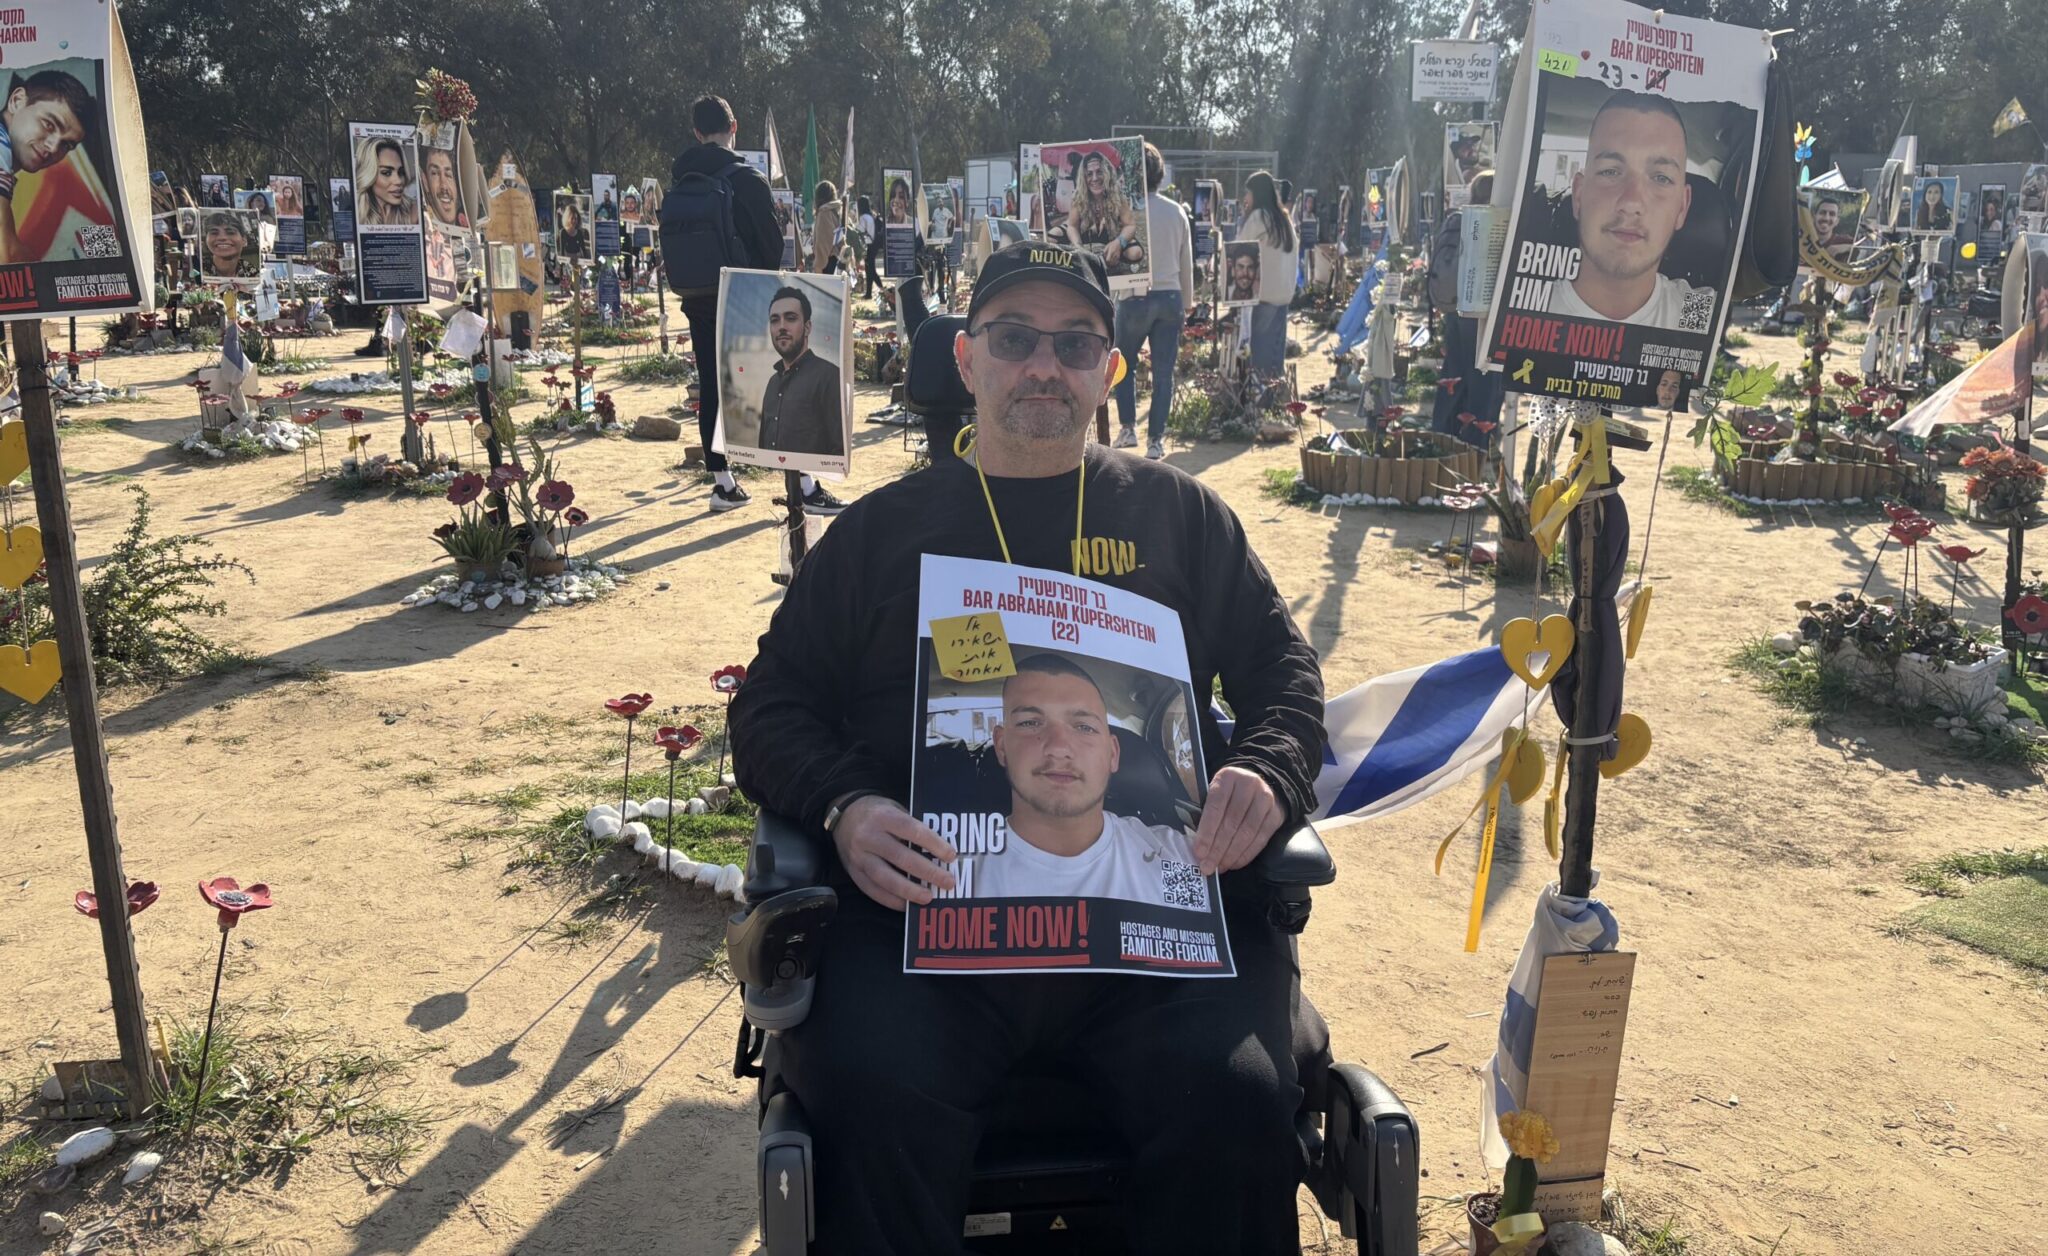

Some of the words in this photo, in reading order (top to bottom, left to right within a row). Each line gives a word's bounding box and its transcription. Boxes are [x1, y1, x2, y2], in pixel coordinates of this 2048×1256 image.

[1626, 19, 1677, 50] קופרשטיין
[1680, 31, 1693, 52] בר
[1610, 38, 1634, 61] BAR
[1636, 44, 1704, 76] KUPERSHTEIN
[1599, 61, 1623, 88] 23
[1516, 240, 1582, 281] BRING
[55, 275, 86, 286] HOSTAGES
[87, 274, 99, 284] AND
[100, 272, 128, 283] MISSING
[57, 284, 97, 299] FAMILIES
[98, 282, 131, 297] FORUM
[1508, 276, 1553, 313] HIM
[1500, 314, 1563, 353] HOME
[1564, 322, 1626, 362] NOW!
[1641, 343, 1669, 357] HOSTAGES
[1669, 346, 1680, 358] AND
[1680, 348, 1703, 361] MISSING
[1545, 377, 1573, 394] בבית
[1573, 360, 1634, 386] קופרשטיין
[1636, 369, 1649, 386] בר
[1576, 379, 1588, 398] לך
[1590, 382, 1621, 400] מחכים
[1018, 576, 1087, 606] קופרשטיין
[1091, 590, 1107, 610] בר
[963, 589, 993, 609] BAR
[997, 592, 1068, 620] ABRAHAM
[1072, 604, 1157, 643] KUPERSHTEIN
[966, 616, 981, 631] אל
[1051, 619, 1079, 644] (22)
[956, 663, 1002, 677] מאחור
[917, 906, 998, 950] HOME
[1006, 900, 1090, 950] NOW!
[1120, 920, 1161, 939] HOSTAGES
[1162, 927, 1178, 941] AND
[1179, 929, 1216, 945] MISSING
[1121, 935, 1174, 960] FAMILIES
[1175, 942, 1220, 963] FORUM
